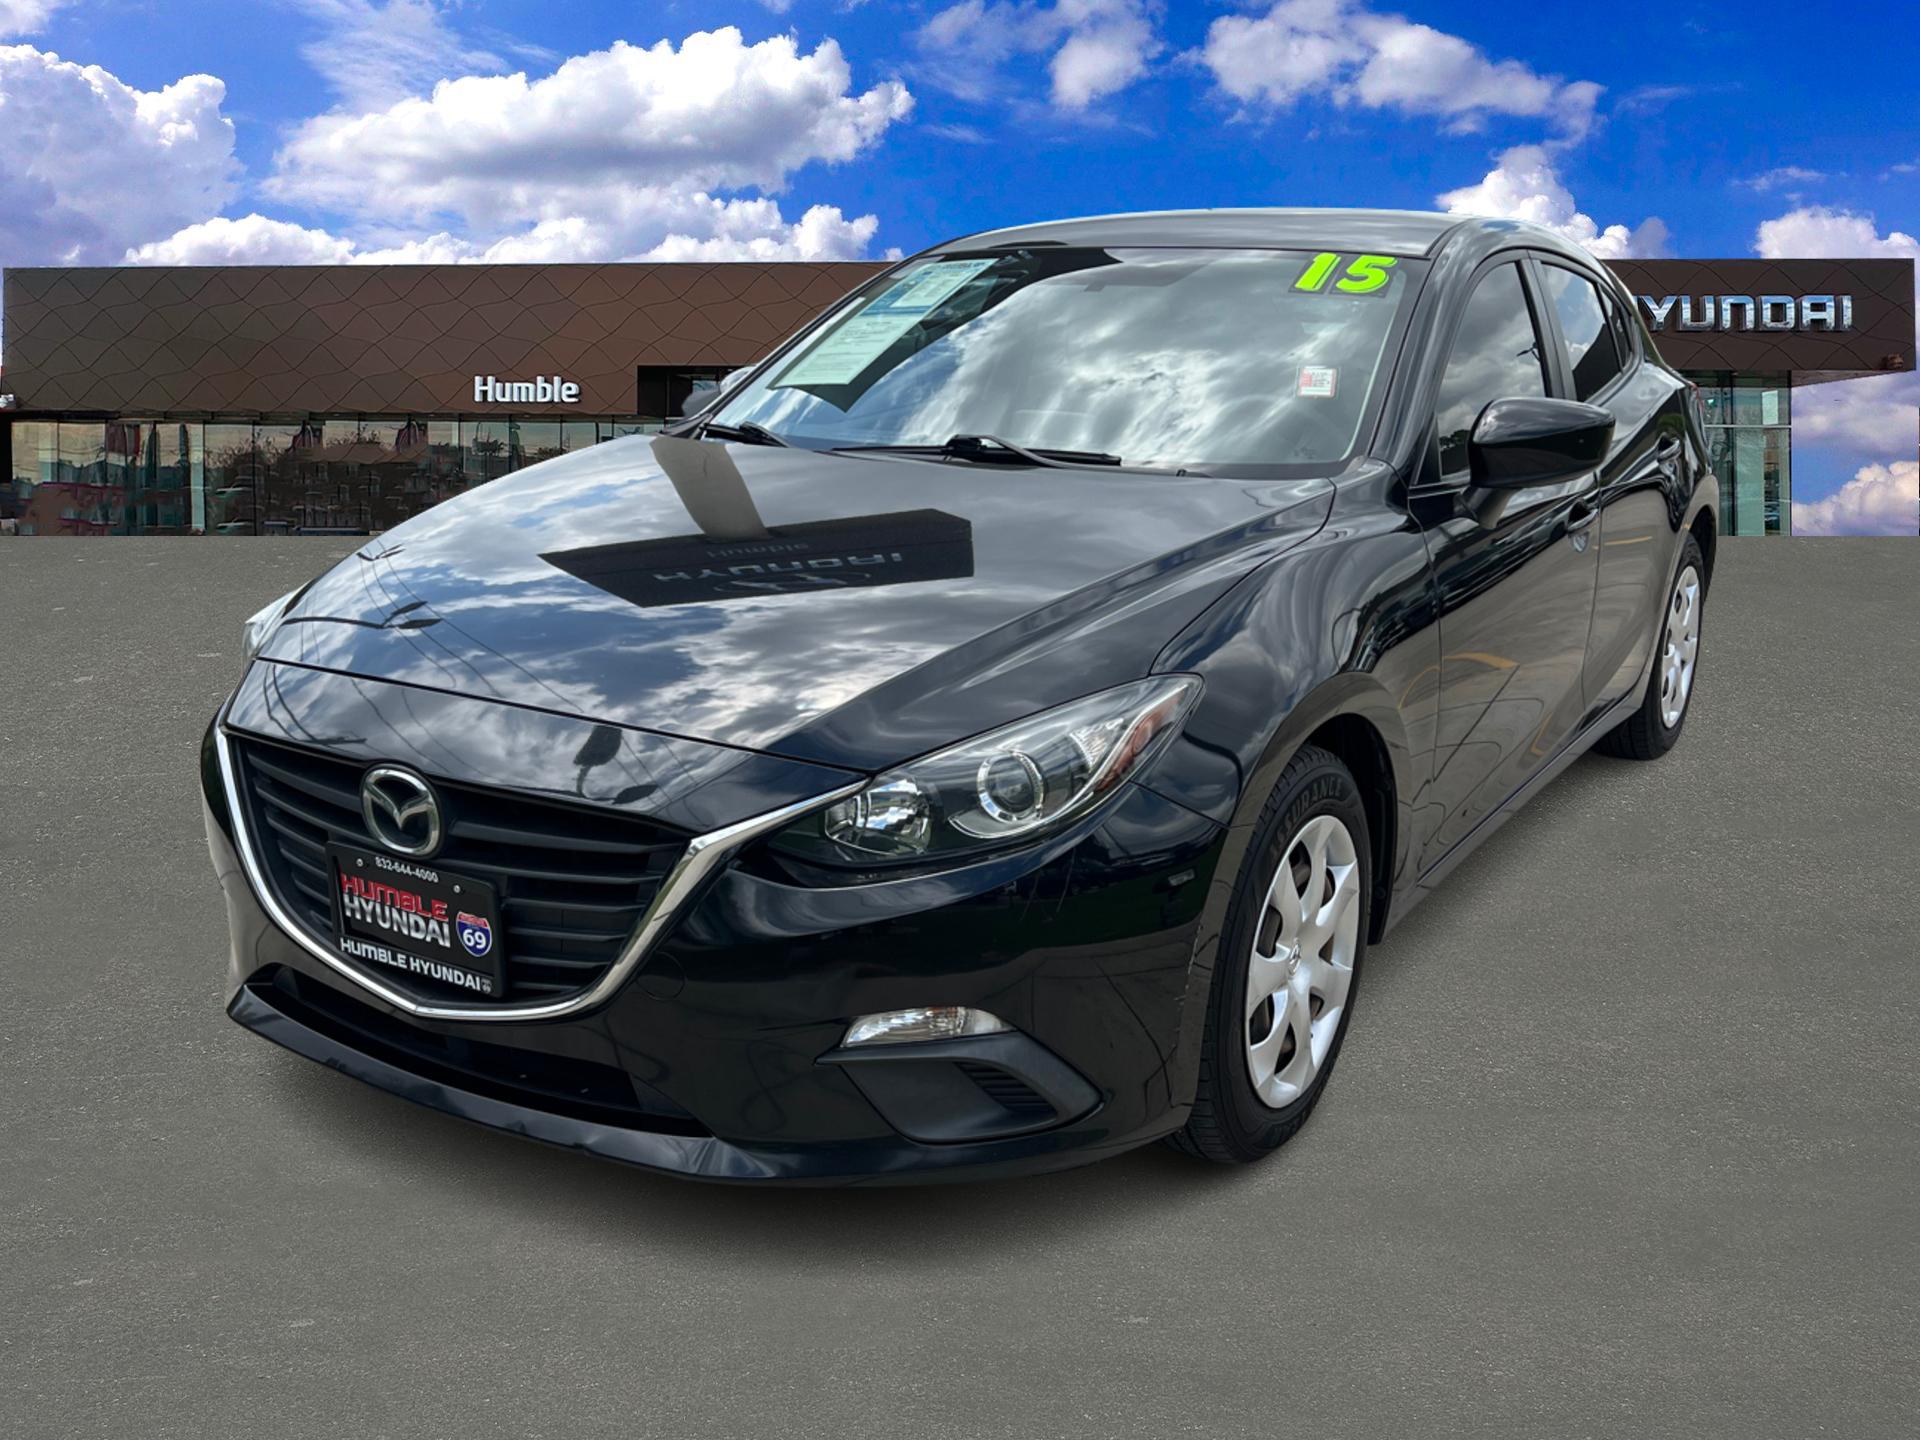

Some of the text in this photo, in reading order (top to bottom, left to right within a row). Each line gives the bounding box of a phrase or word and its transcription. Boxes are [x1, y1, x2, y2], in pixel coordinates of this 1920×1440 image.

[1295, 252, 1398, 293] 15
[1633, 295, 1852, 331] YUNDAI
[474, 375, 580, 402] Humble
[375, 856, 439, 883] 832-644-4000
[341, 873, 449, 922] HUMBLE
[343, 894, 450, 948] HYUNDAI
[463, 929, 487, 949] 69
[340, 938, 407, 969] HUMBLE
[409, 958, 481, 991] HYUNDAI
